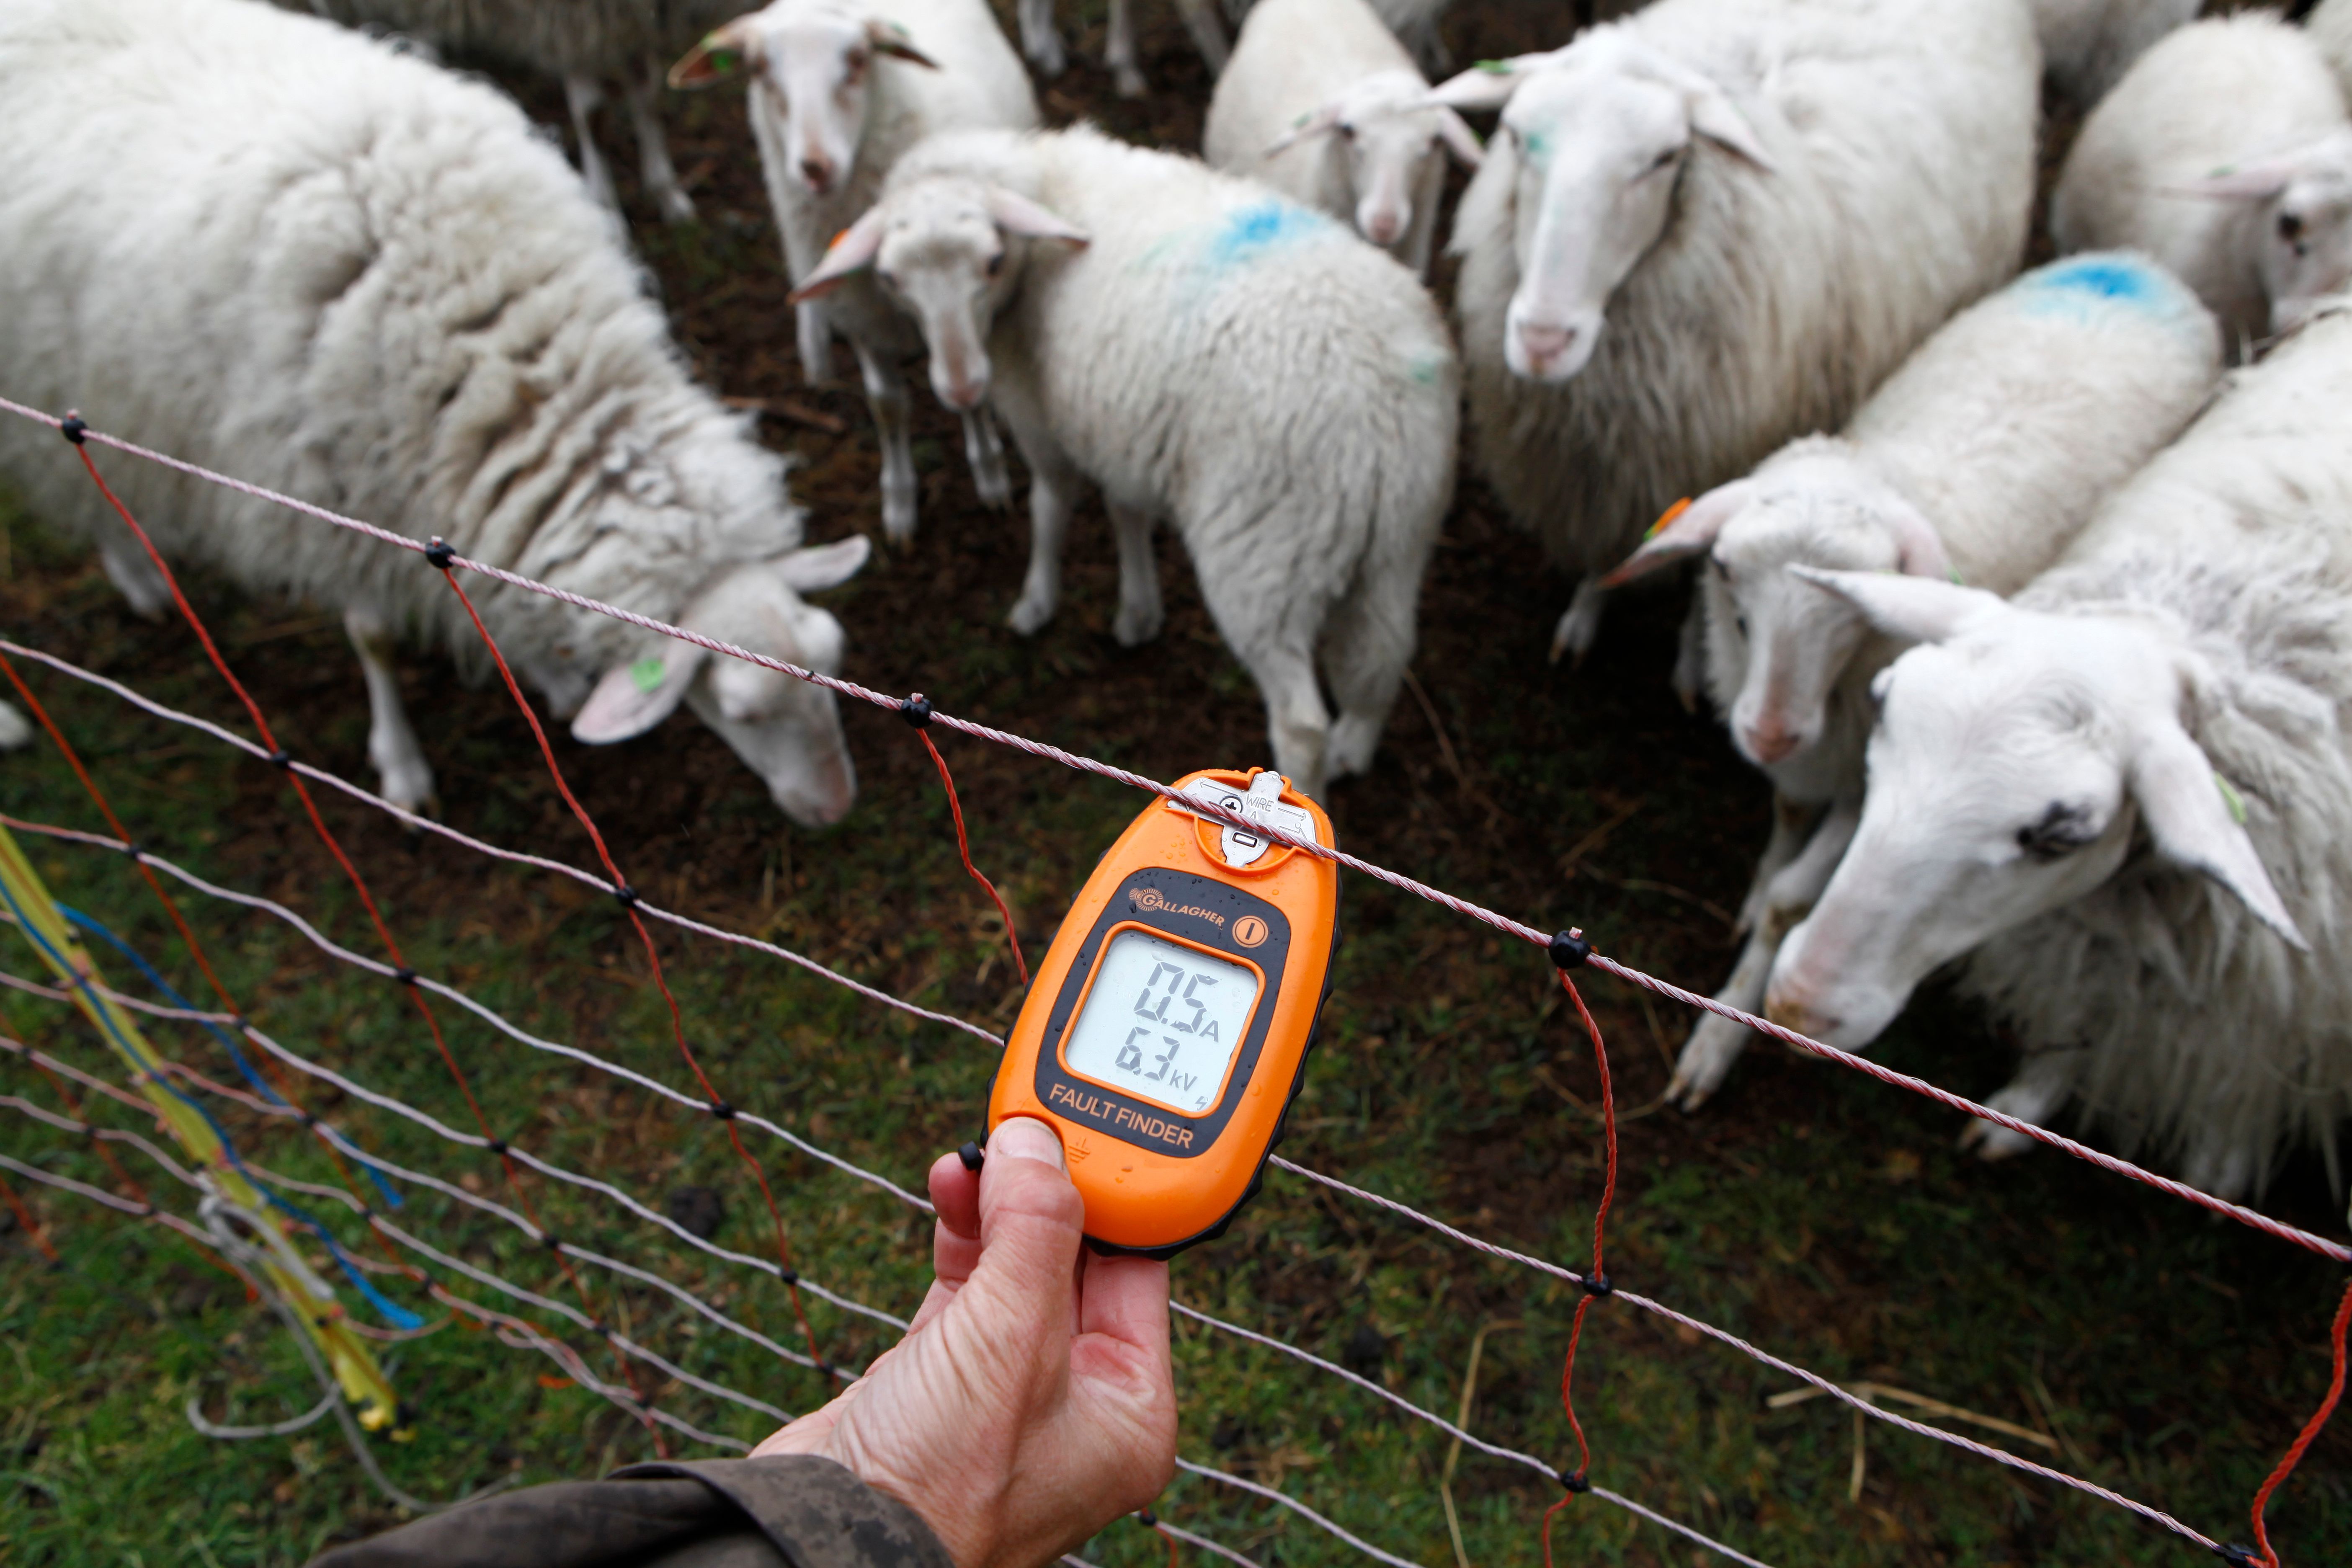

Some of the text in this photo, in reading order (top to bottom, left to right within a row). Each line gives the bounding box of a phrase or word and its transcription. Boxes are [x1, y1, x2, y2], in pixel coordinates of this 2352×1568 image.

[1246, 794, 1274, 812] WIRE
[1142, 894, 1225, 926] GALLAGHER
[1049, 1083, 1194, 1149] FAULT FINDER
